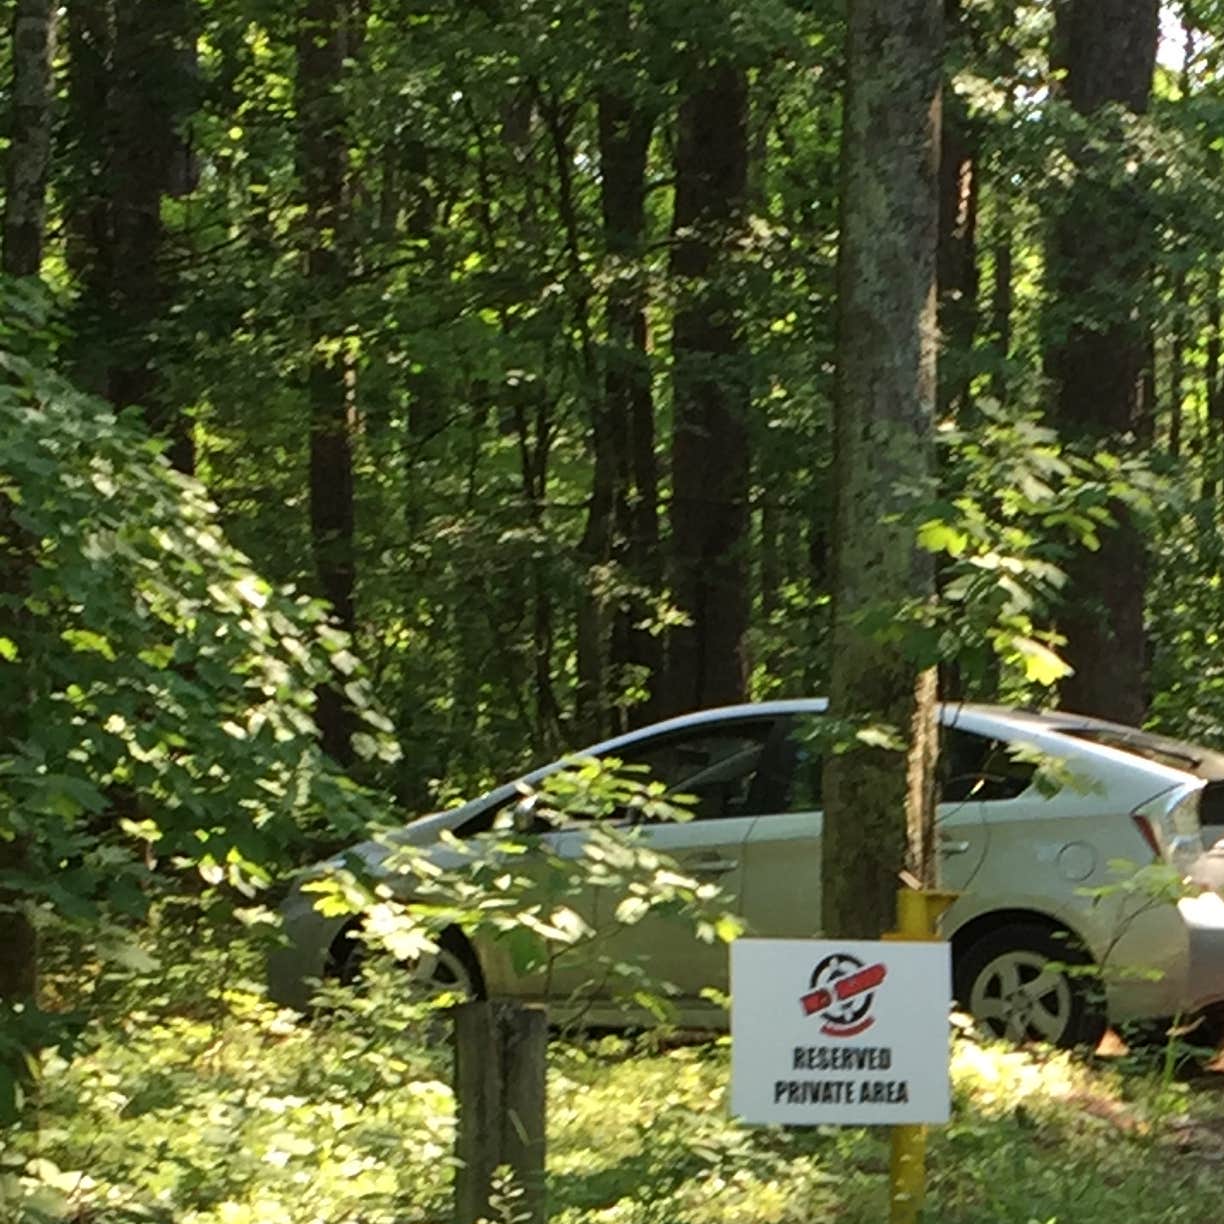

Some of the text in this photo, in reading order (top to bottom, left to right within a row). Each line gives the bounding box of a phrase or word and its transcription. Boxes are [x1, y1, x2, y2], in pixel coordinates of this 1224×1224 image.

[793, 1047, 891, 1071] RESERVED
[774, 1080, 908, 1104] PRIVATE AREA
